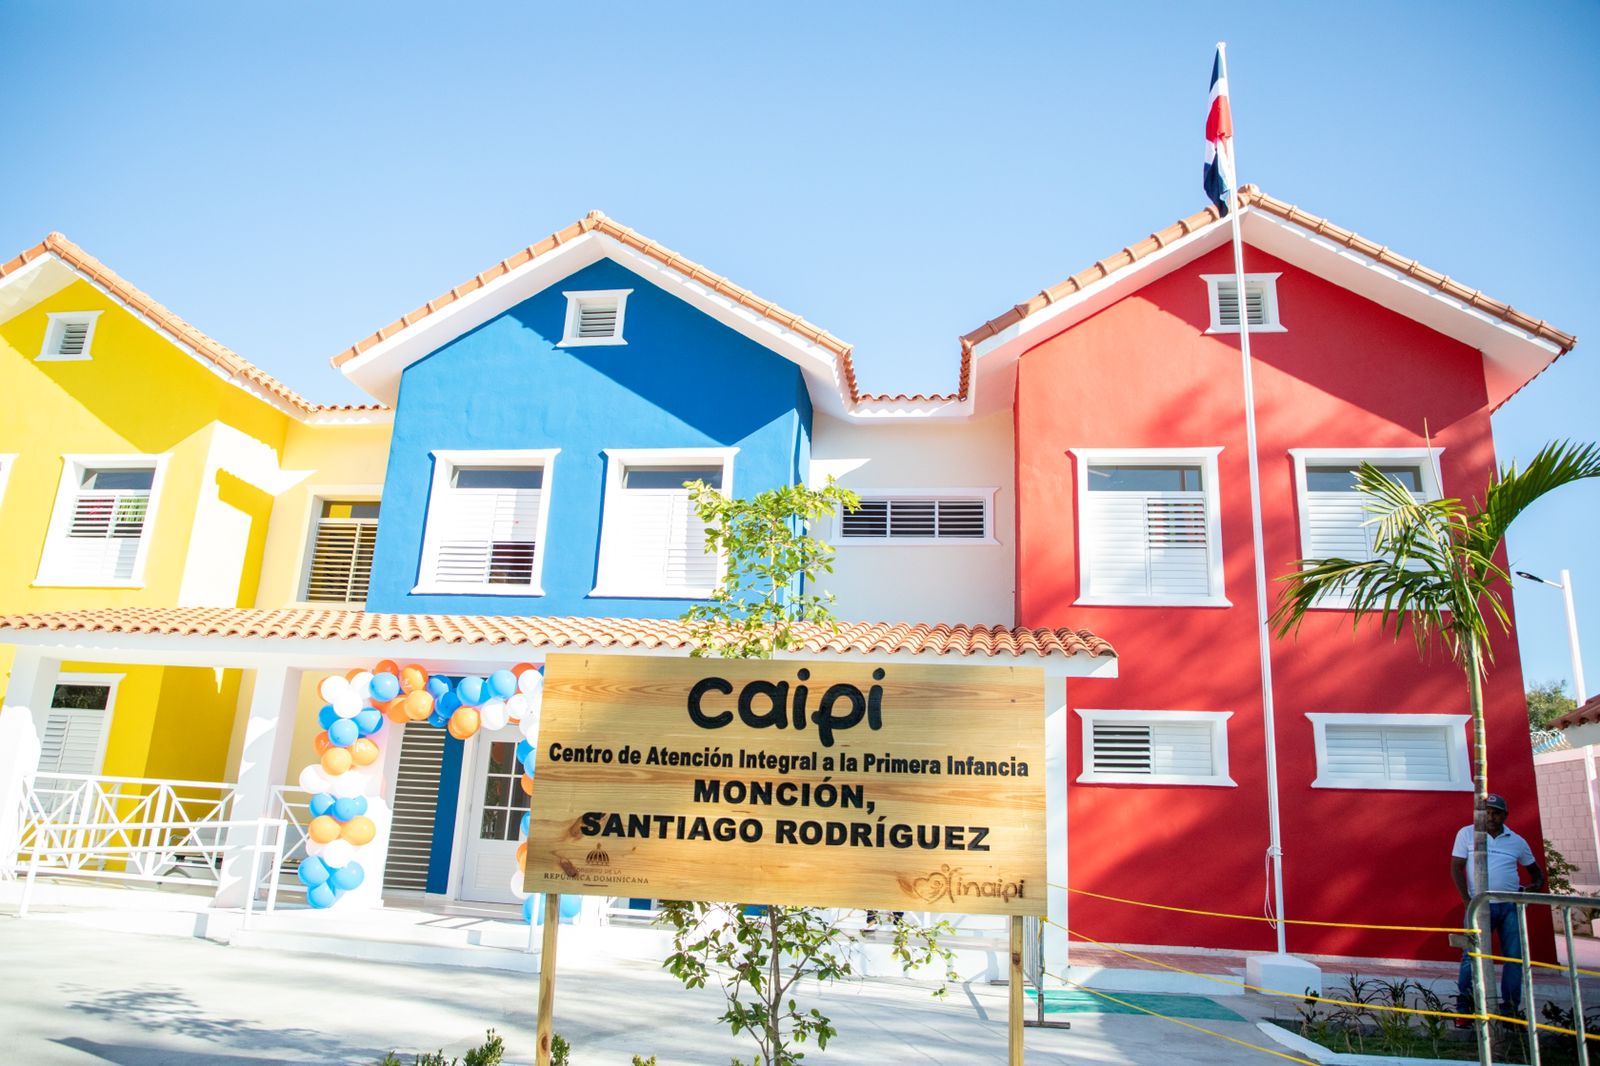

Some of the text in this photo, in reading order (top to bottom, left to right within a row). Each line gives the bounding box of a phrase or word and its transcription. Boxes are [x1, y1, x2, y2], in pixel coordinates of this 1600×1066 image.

[687, 668, 885, 747] caipi
[550, 743, 1029, 777] Centro de Atención Integral a la Primera Infancia
[694, 777, 875, 814] MONCIÓN,
[581, 811, 990, 851] SANTIAGO RODRÍGUEZ
[593, 874, 649, 885] DOMINICANA
[956, 876, 1025, 903] inaipi
